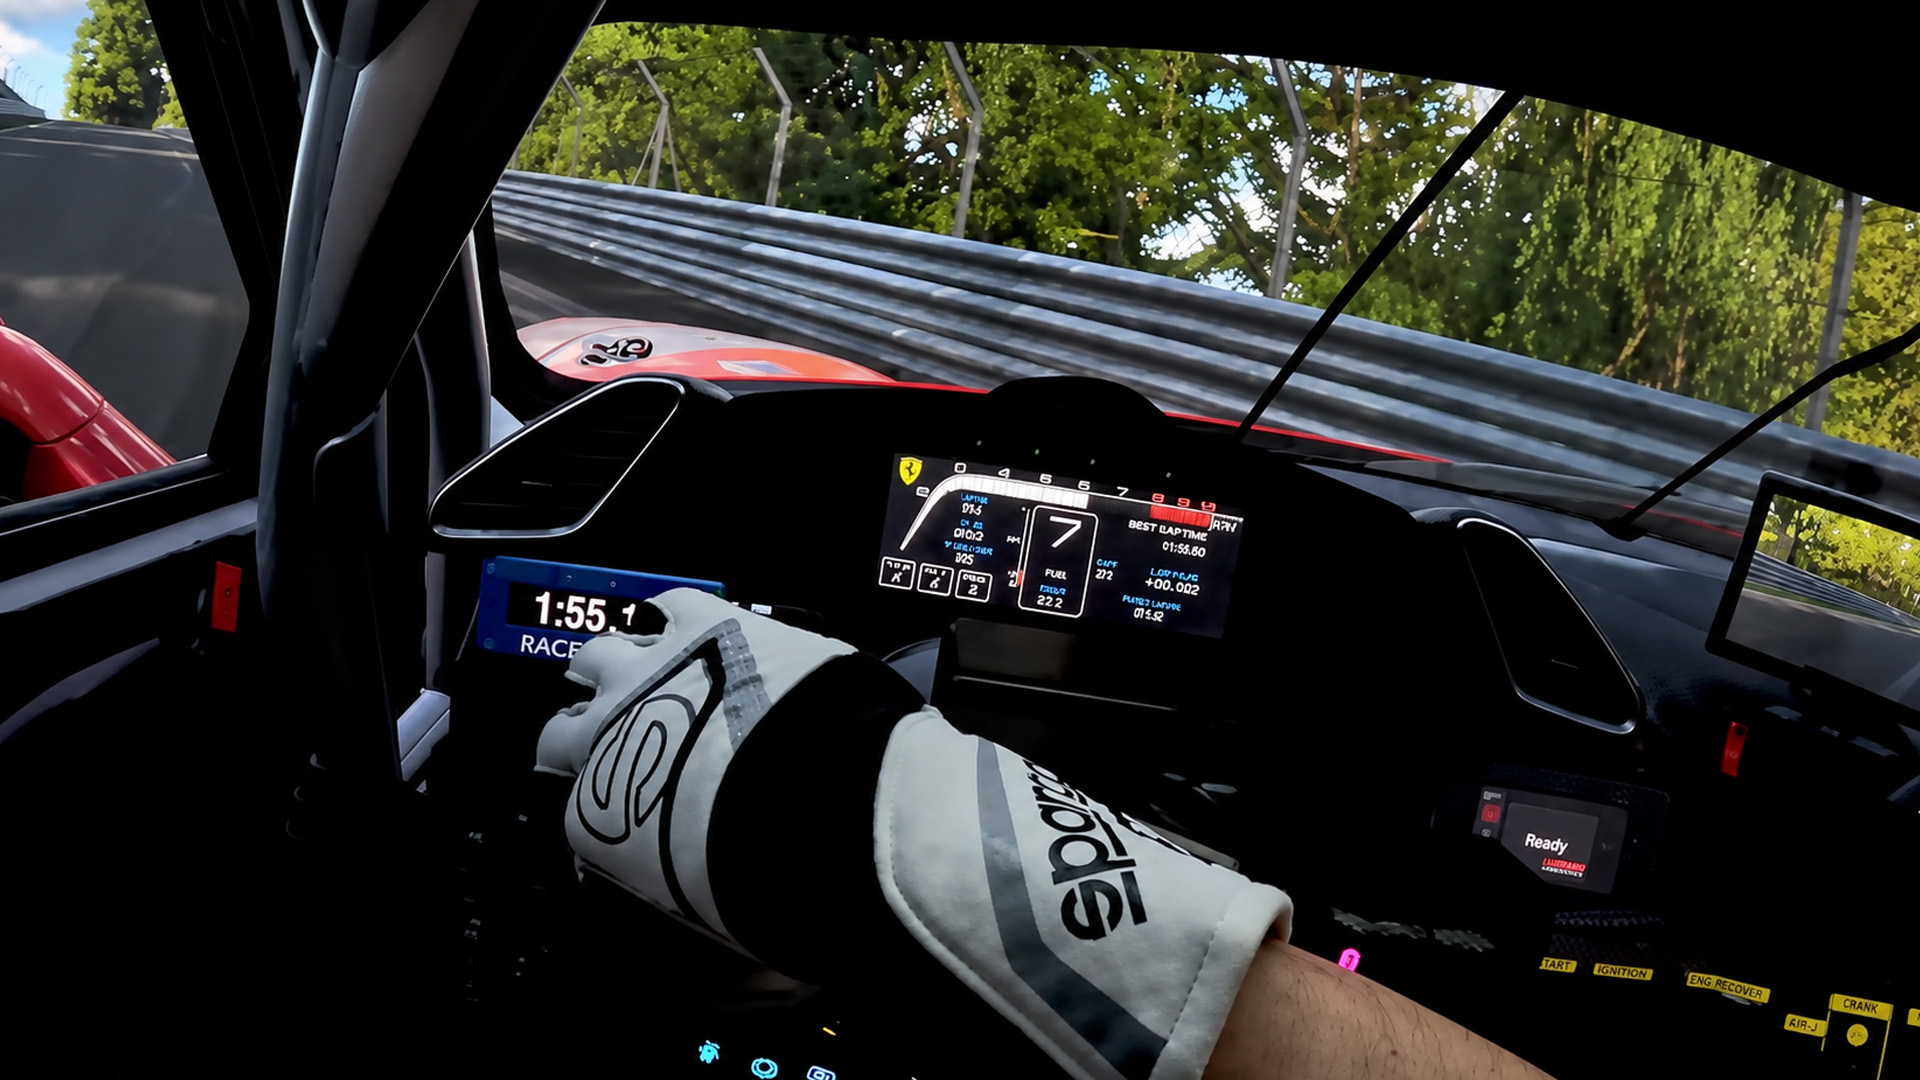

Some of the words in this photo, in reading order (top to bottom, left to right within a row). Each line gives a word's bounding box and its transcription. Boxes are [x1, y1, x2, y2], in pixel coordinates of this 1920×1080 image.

[1117, 486, 1129, 497] 7
[1152, 493, 1165, 503] 8
[1050, 515, 1082, 548] 7
[1128, 519, 1157, 532] BEST
[1045, 568, 1067, 580] FUEL
[1524, 832, 1569, 856] Ready
[1541, 958, 1571, 971] TART
[1597, 965, 1648, 979] IGNITION
[1689, 974, 1712, 988] ENG
[1714, 978, 1763, 1000] RECOVER
[1843, 998, 1879, 1014] CRANK
[1788, 1017, 1818, 1033] AIR-J
